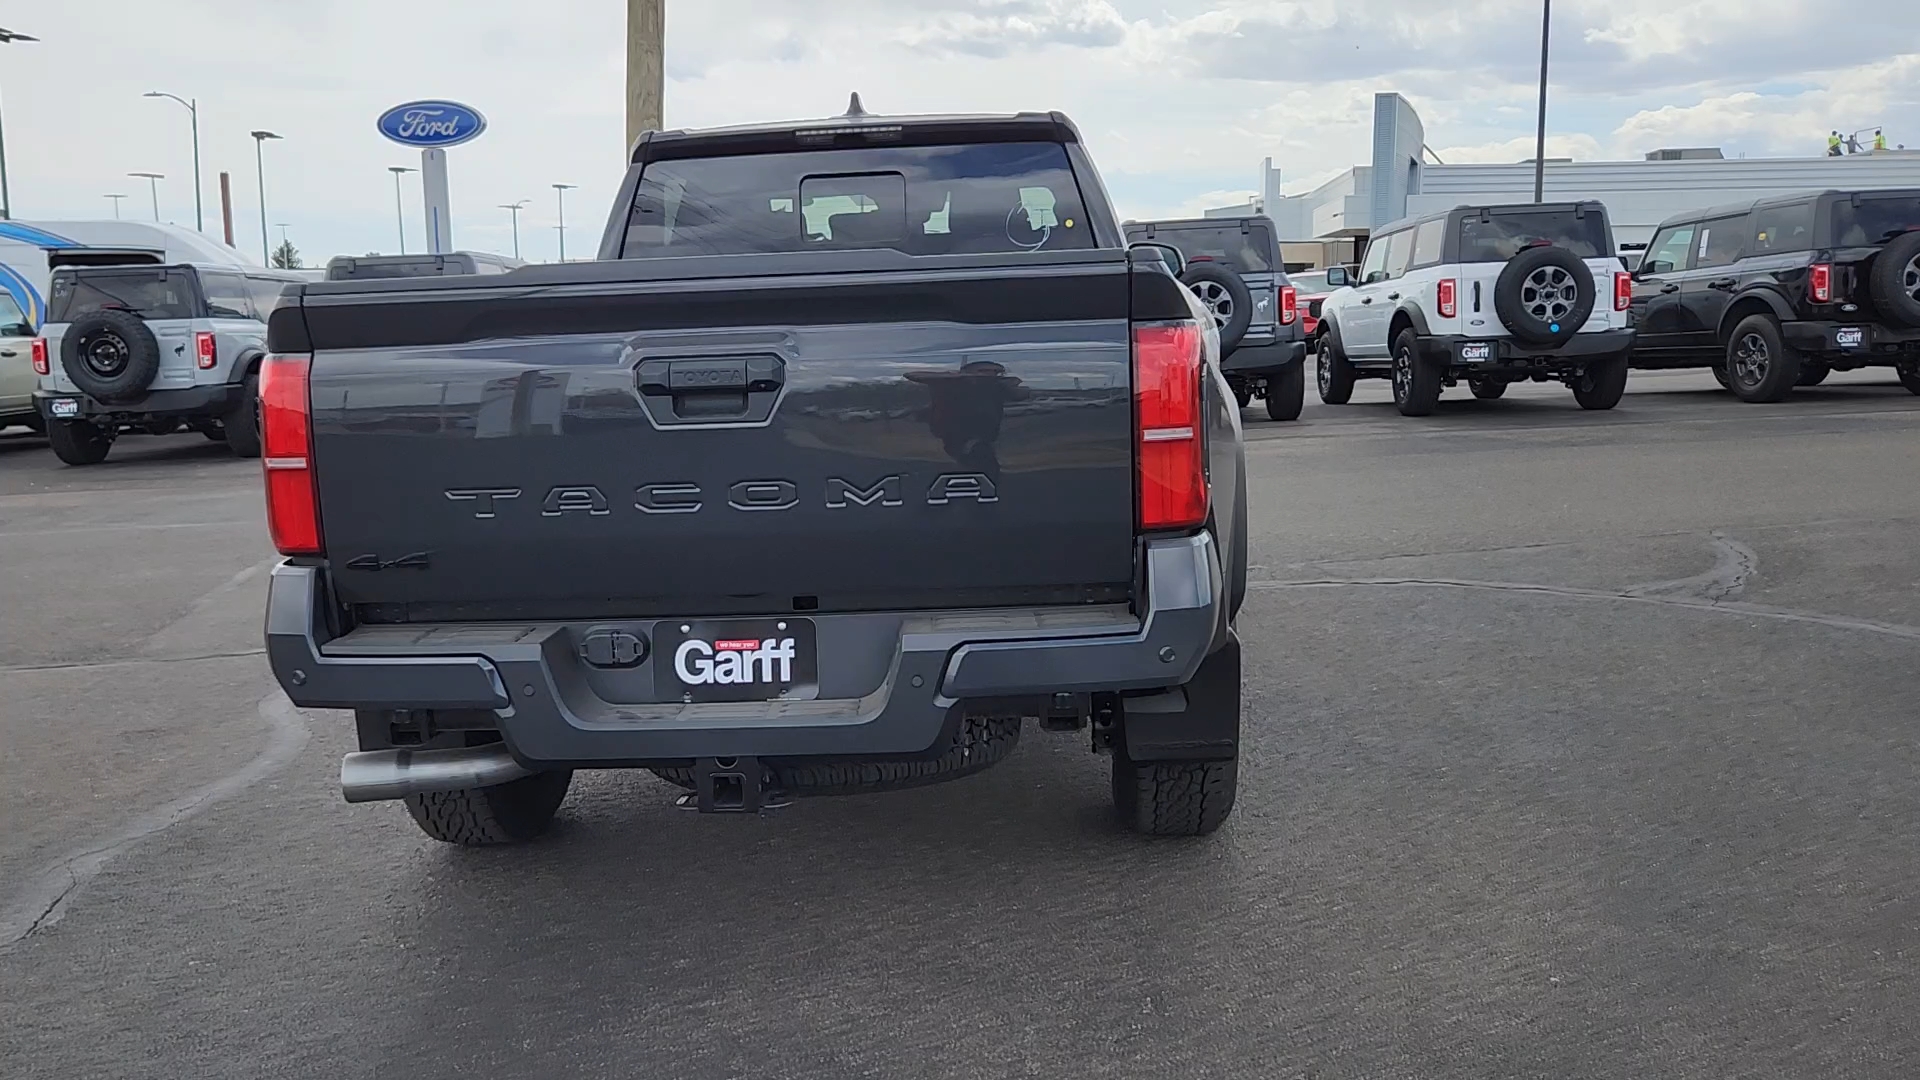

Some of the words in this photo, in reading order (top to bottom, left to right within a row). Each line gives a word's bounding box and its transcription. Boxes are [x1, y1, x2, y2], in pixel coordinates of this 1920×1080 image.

[398, 109, 460, 137] Ford
[1836, 331, 1862, 343] Garff
[1461, 346, 1489, 359] Garff
[672, 368, 743, 384] TOYOTA
[444, 473, 999, 518] TACOMA
[728, 640, 741, 648] hear
[742, 641, 755, 649] you
[674, 638, 795, 685] Garff
